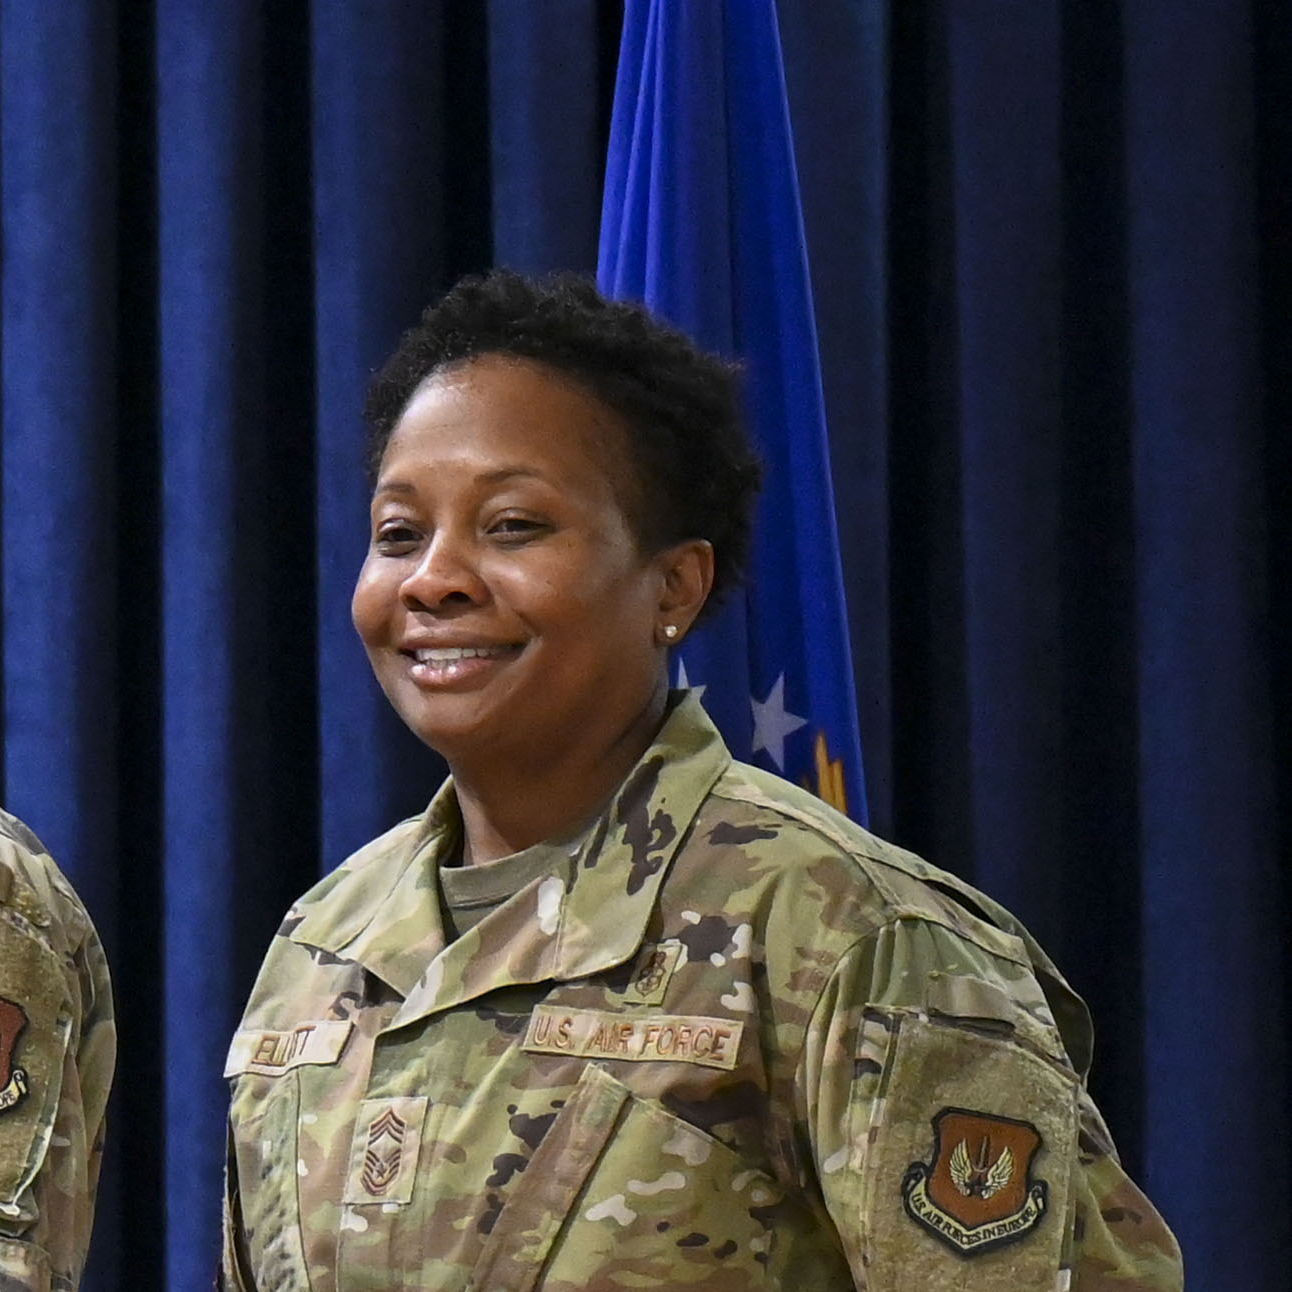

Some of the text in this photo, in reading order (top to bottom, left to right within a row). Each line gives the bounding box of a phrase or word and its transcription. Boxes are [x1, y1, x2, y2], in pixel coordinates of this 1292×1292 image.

[534, 1016, 731, 1061] U.S. AIR FORCE
[923, 1210, 944, 1228] AIR
[982, 1227, 996, 1240] IN
[997, 1206, 1037, 1235] EUROPE
